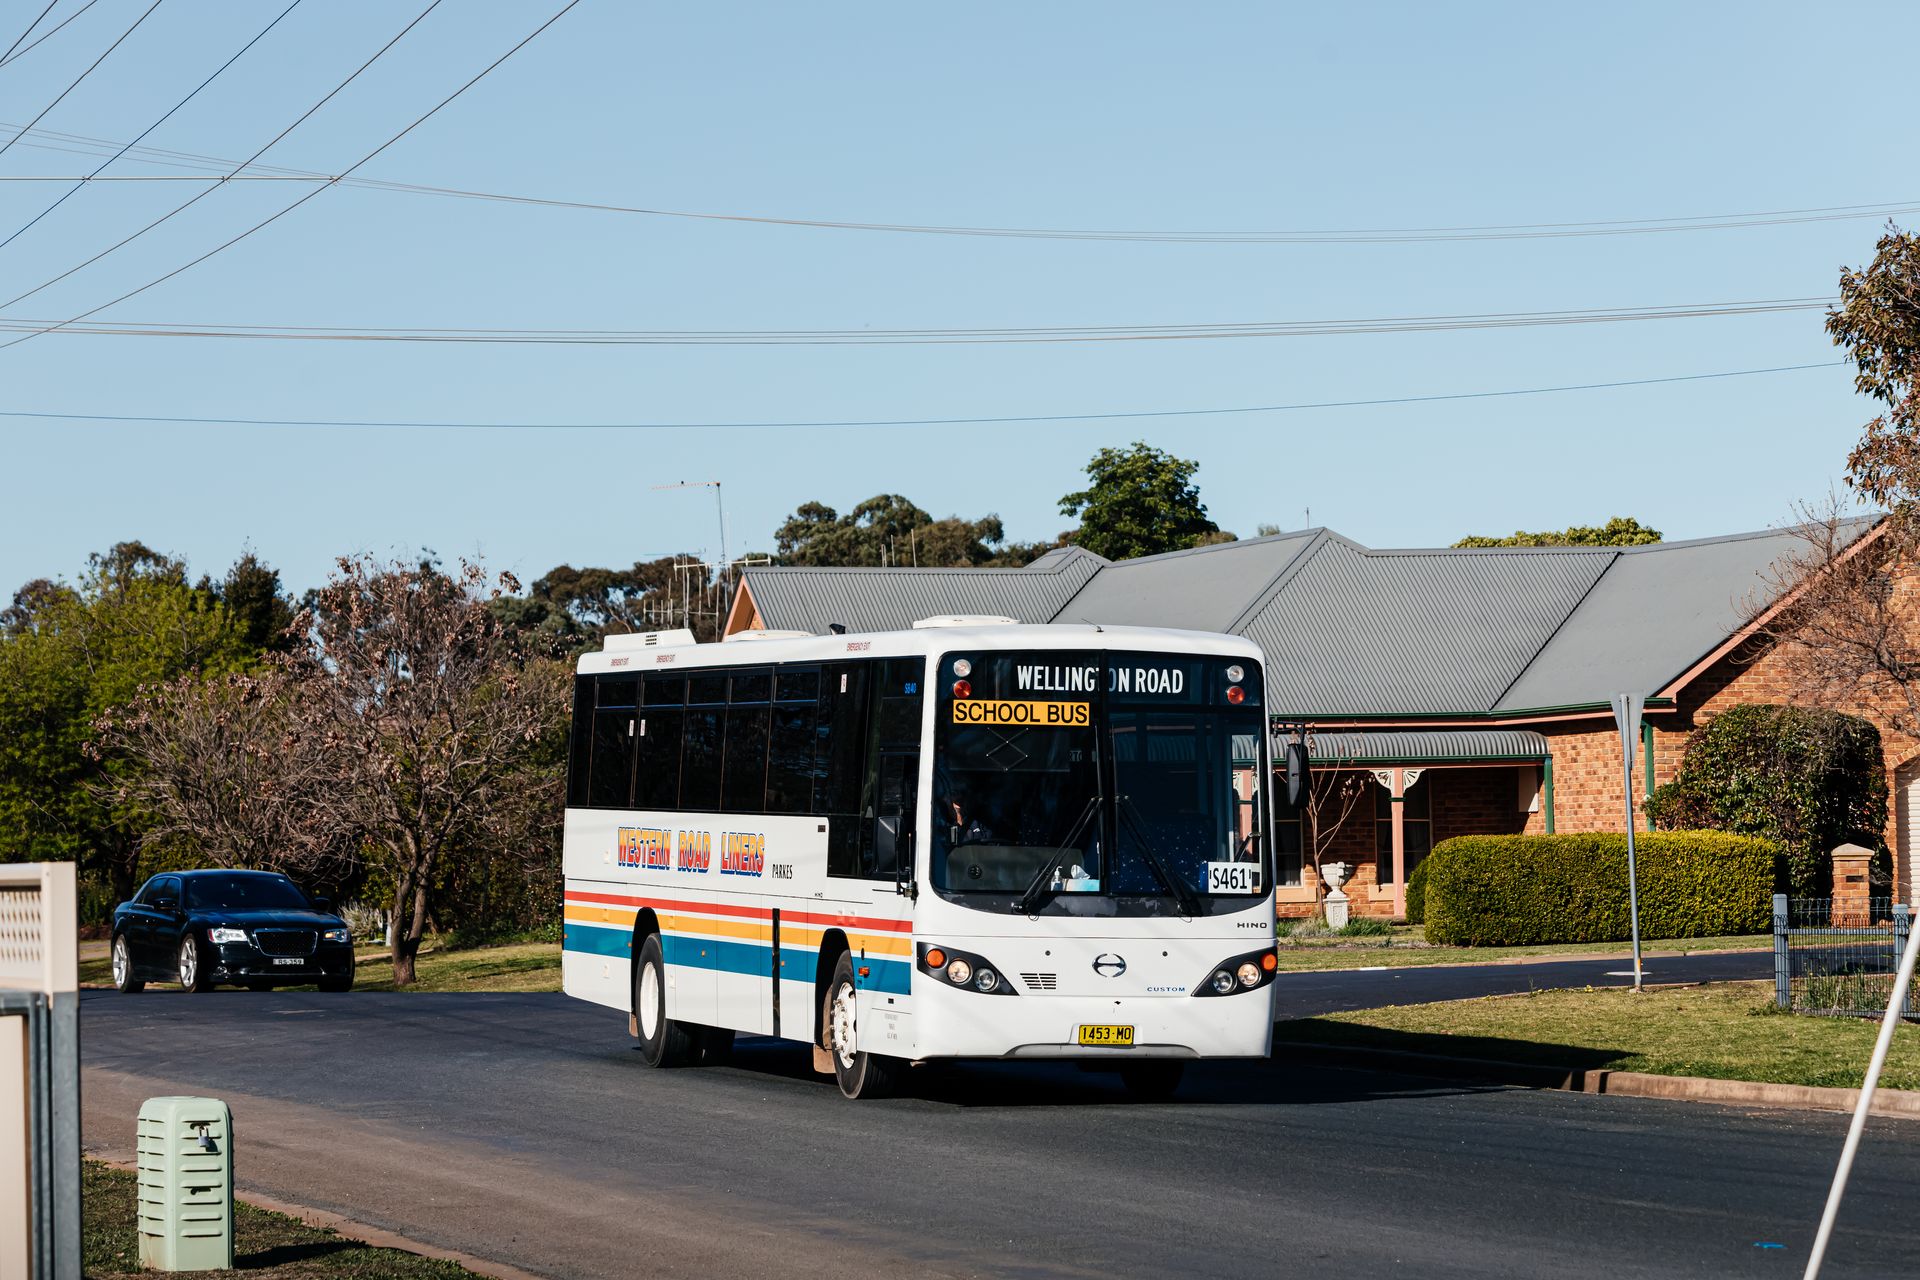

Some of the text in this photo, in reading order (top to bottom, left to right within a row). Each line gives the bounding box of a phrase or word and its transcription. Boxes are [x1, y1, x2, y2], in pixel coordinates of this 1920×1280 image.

[1017, 665, 1184, 694] WELLINGON ROAD
[955, 702, 1088, 724] SCHOOL BUS
[618, 827, 765, 877] WESTERN ROAD LINERS
[772, 864, 793, 879] PARKES
